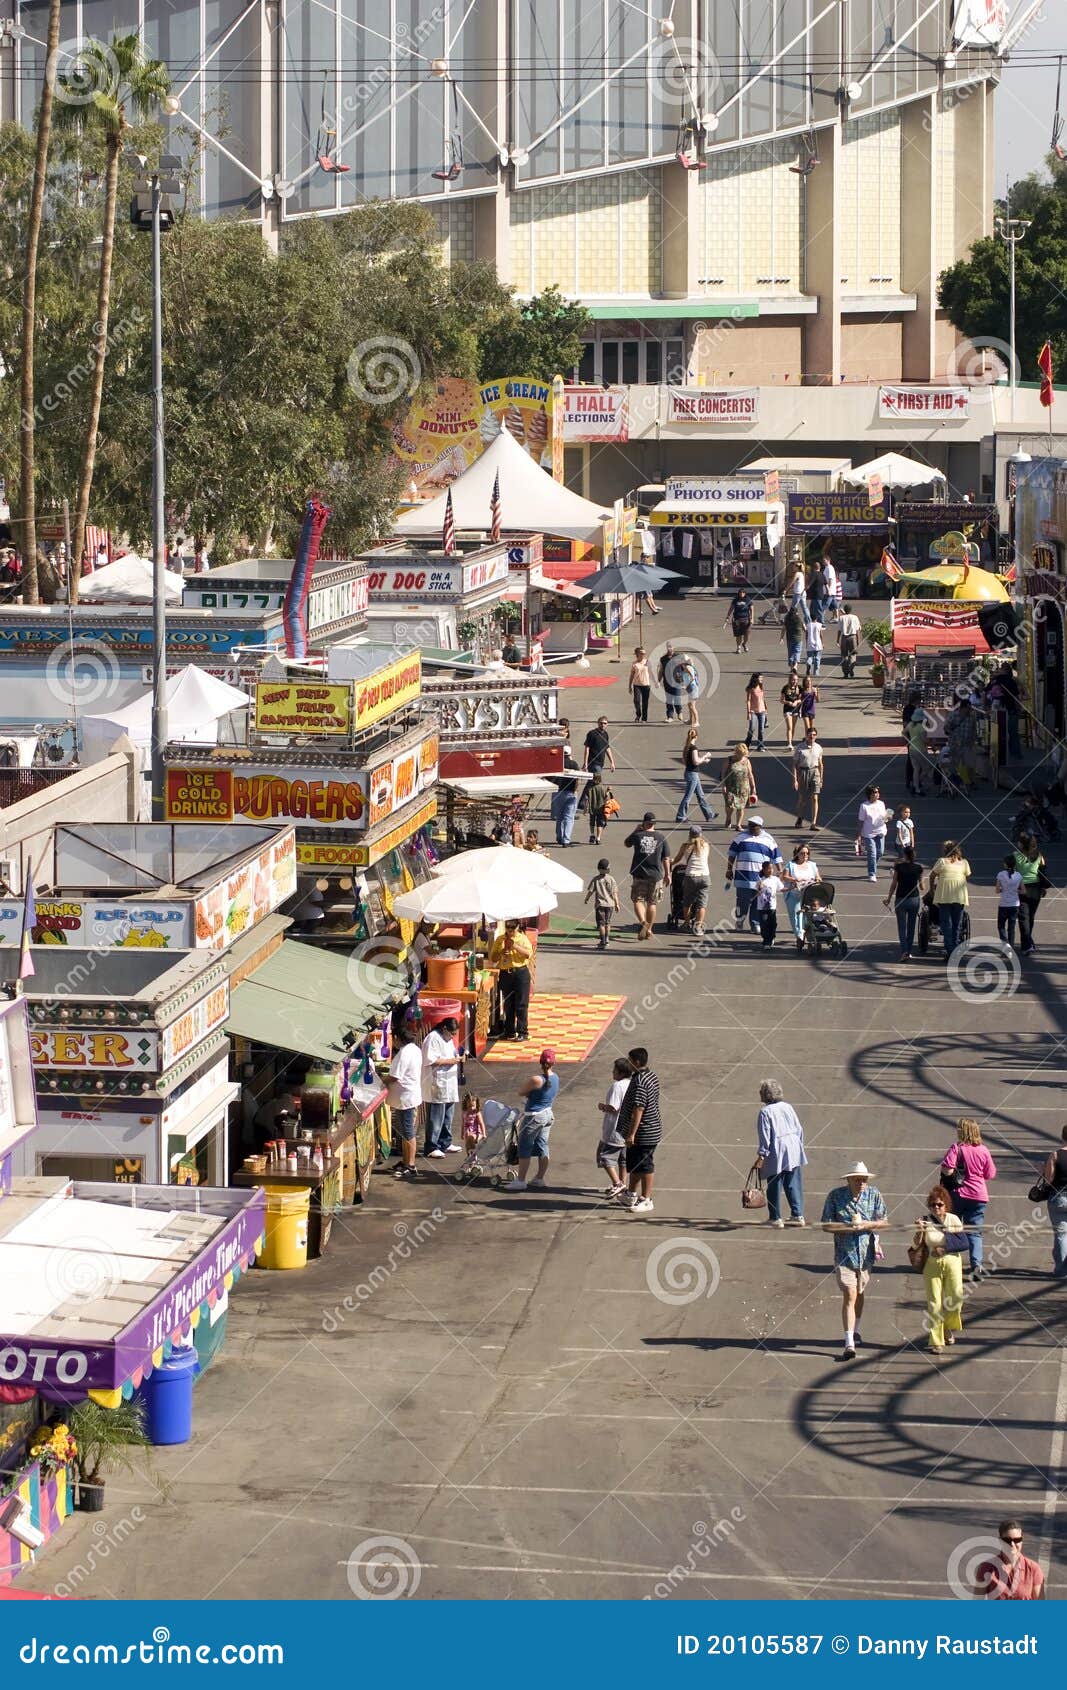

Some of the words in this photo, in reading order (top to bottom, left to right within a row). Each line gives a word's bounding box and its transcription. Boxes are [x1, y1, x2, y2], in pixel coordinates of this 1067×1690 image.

[479, 384, 501, 406] ICE
[504, 382, 550, 403] CREAM
[576, 396, 616, 411] HALL
[673, 398, 696, 413] FREE
[698, 397, 755, 414] CONCERTS!
[897, 393, 930, 410] FIRST
[933, 393, 953, 410] AID
[435, 412, 462, 422] MINI
[418, 419, 479, 434] DONUTS
[674, 489, 722, 500] PHOTO
[727, 489, 765, 500] SHOP
[804, 496, 840, 505] CUSTOM
[843, 496, 869, 505] FITTE
[667, 513, 749, 524] PHOTOS
[792, 506, 826, 521] TOE
[831, 506, 886, 521] RINGS
[367, 572, 388, 590] OT
[392, 571, 426, 590] DOG
[430, 573, 442, 581] ON
[428, 581, 453, 591] STICK
[201, 593, 286, 608] PIZZ
[0, 630, 140, 642] MEXCAN
[165, 632, 232, 643] OOD
[135, 643, 204, 651] TOADAS
[262, 688, 291, 705] NEW
[187, 774, 214, 786] ICE
[178, 788, 221, 800] COLD
[234, 774, 364, 822] BURGERS
[172, 801, 228, 815] DRINKS
[313, 849, 364, 863] FOOD
[37, 916, 82, 930] OOD
[95, 910, 128, 921] ICE
[129, 910, 183, 922] COLD
[174, 1266, 214, 1327] Picture
[215, 1227, 244, 1281] Time!
[0, 1348, 88, 1384] OTO
